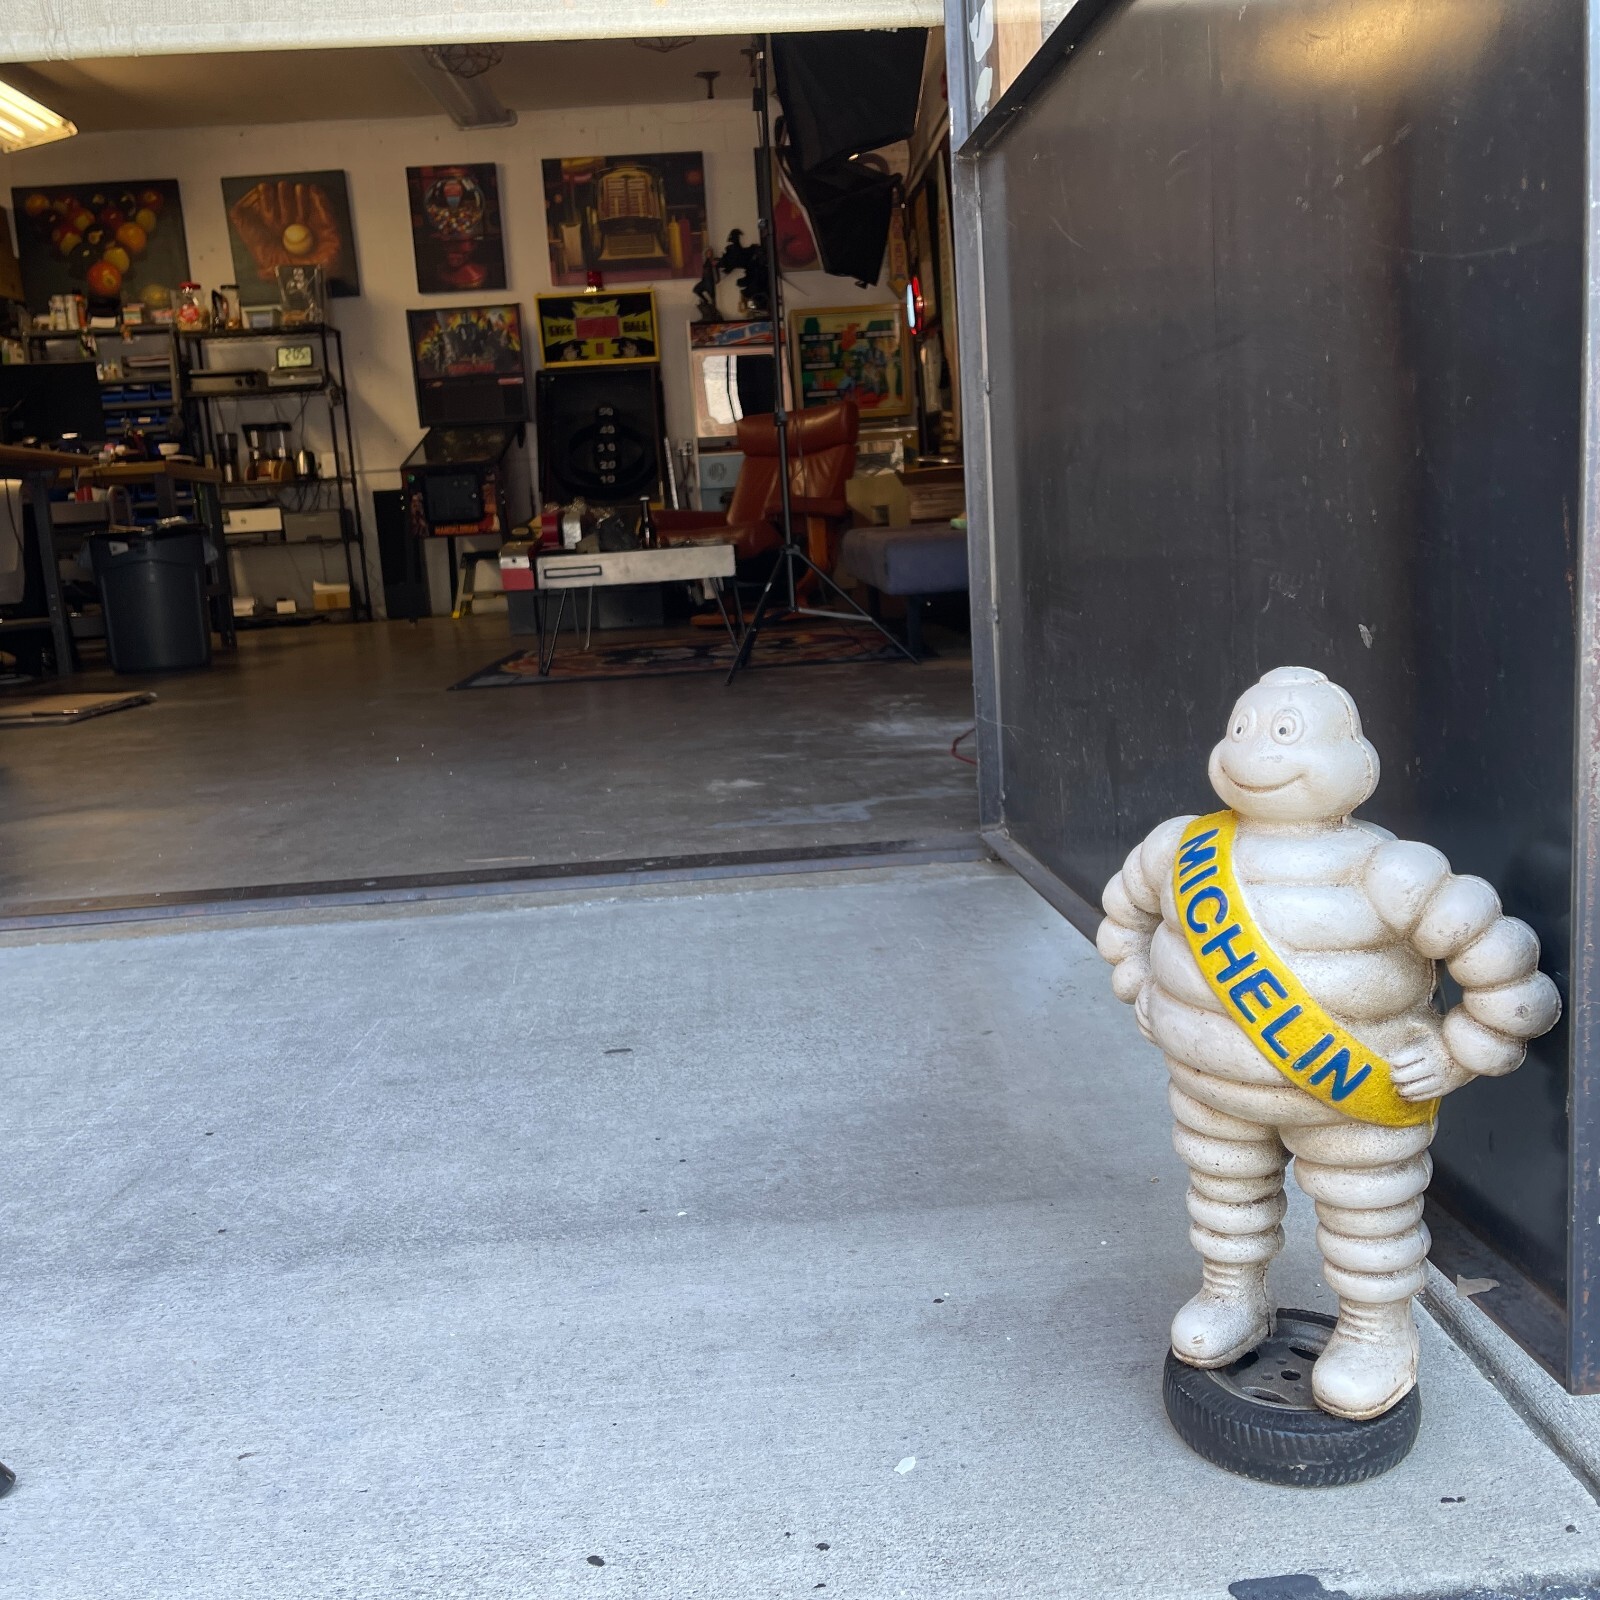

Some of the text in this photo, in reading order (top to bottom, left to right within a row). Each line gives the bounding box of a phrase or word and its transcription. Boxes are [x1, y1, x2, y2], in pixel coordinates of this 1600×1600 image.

[599, 460, 617, 470] 20
[599, 474, 616, 484] 10
[1178, 828, 1373, 1102] MICHELIN
